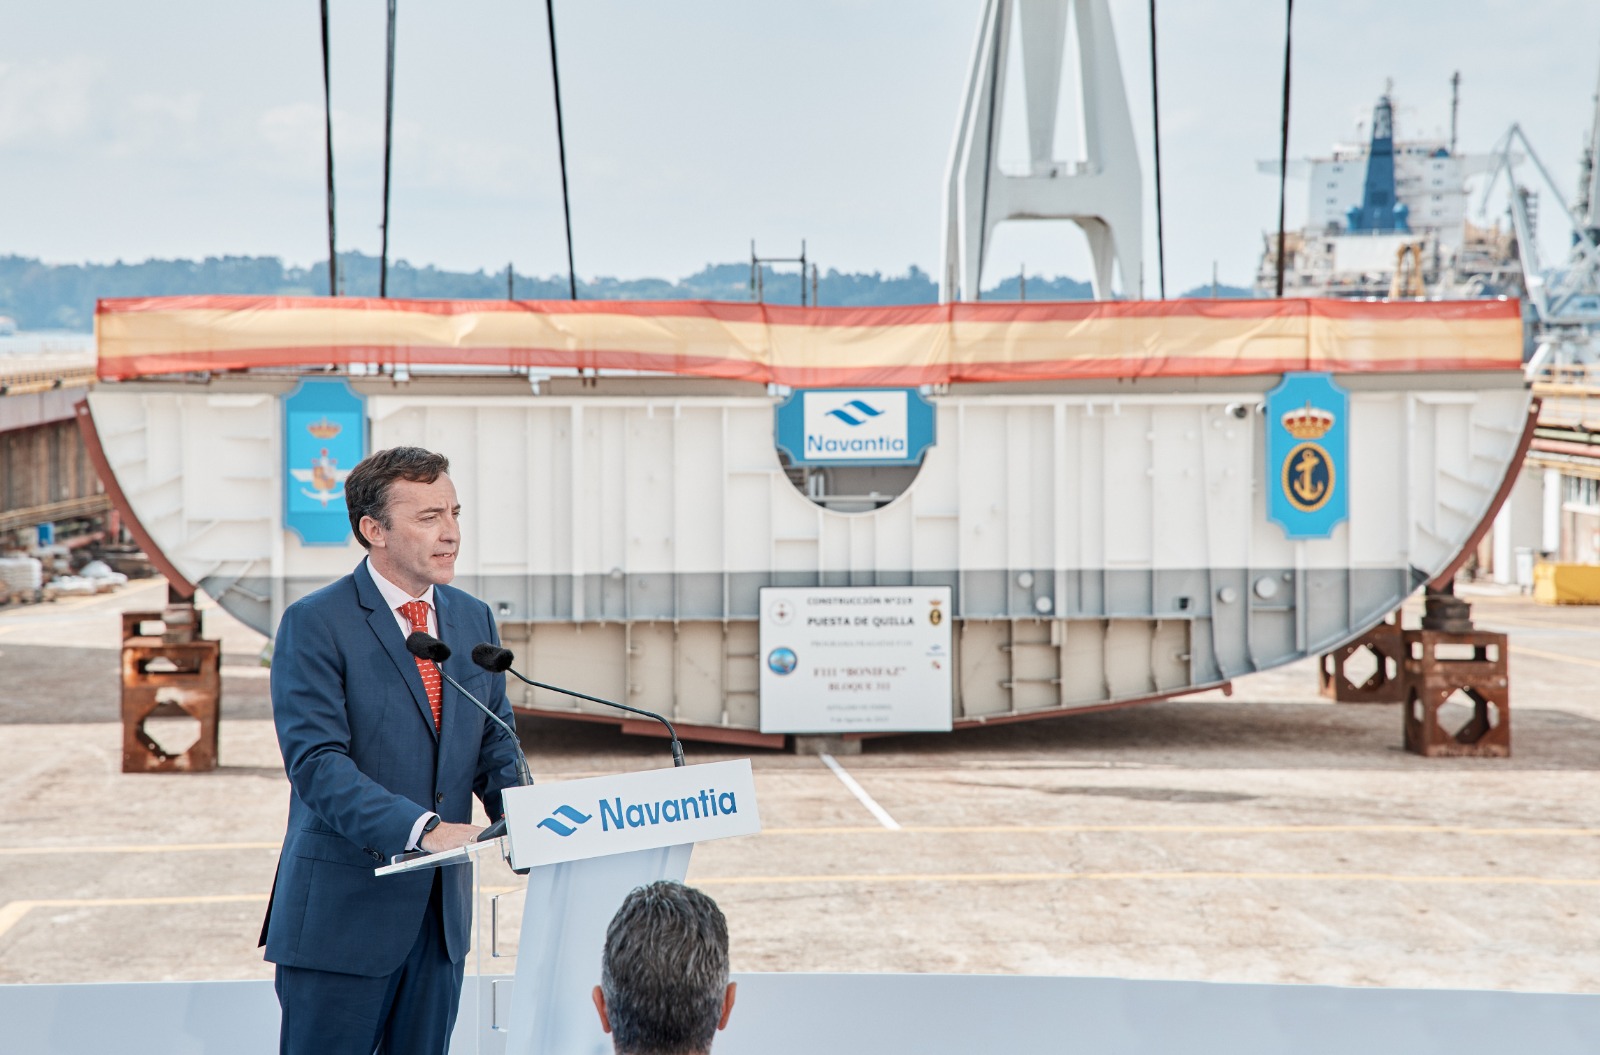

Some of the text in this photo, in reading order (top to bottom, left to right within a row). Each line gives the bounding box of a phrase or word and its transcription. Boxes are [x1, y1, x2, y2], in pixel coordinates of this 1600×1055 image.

[808, 435, 904, 452] Navantia
[807, 616, 915, 628] PUESTA DE QUILLA
[599, 788, 738, 832] Navantia
